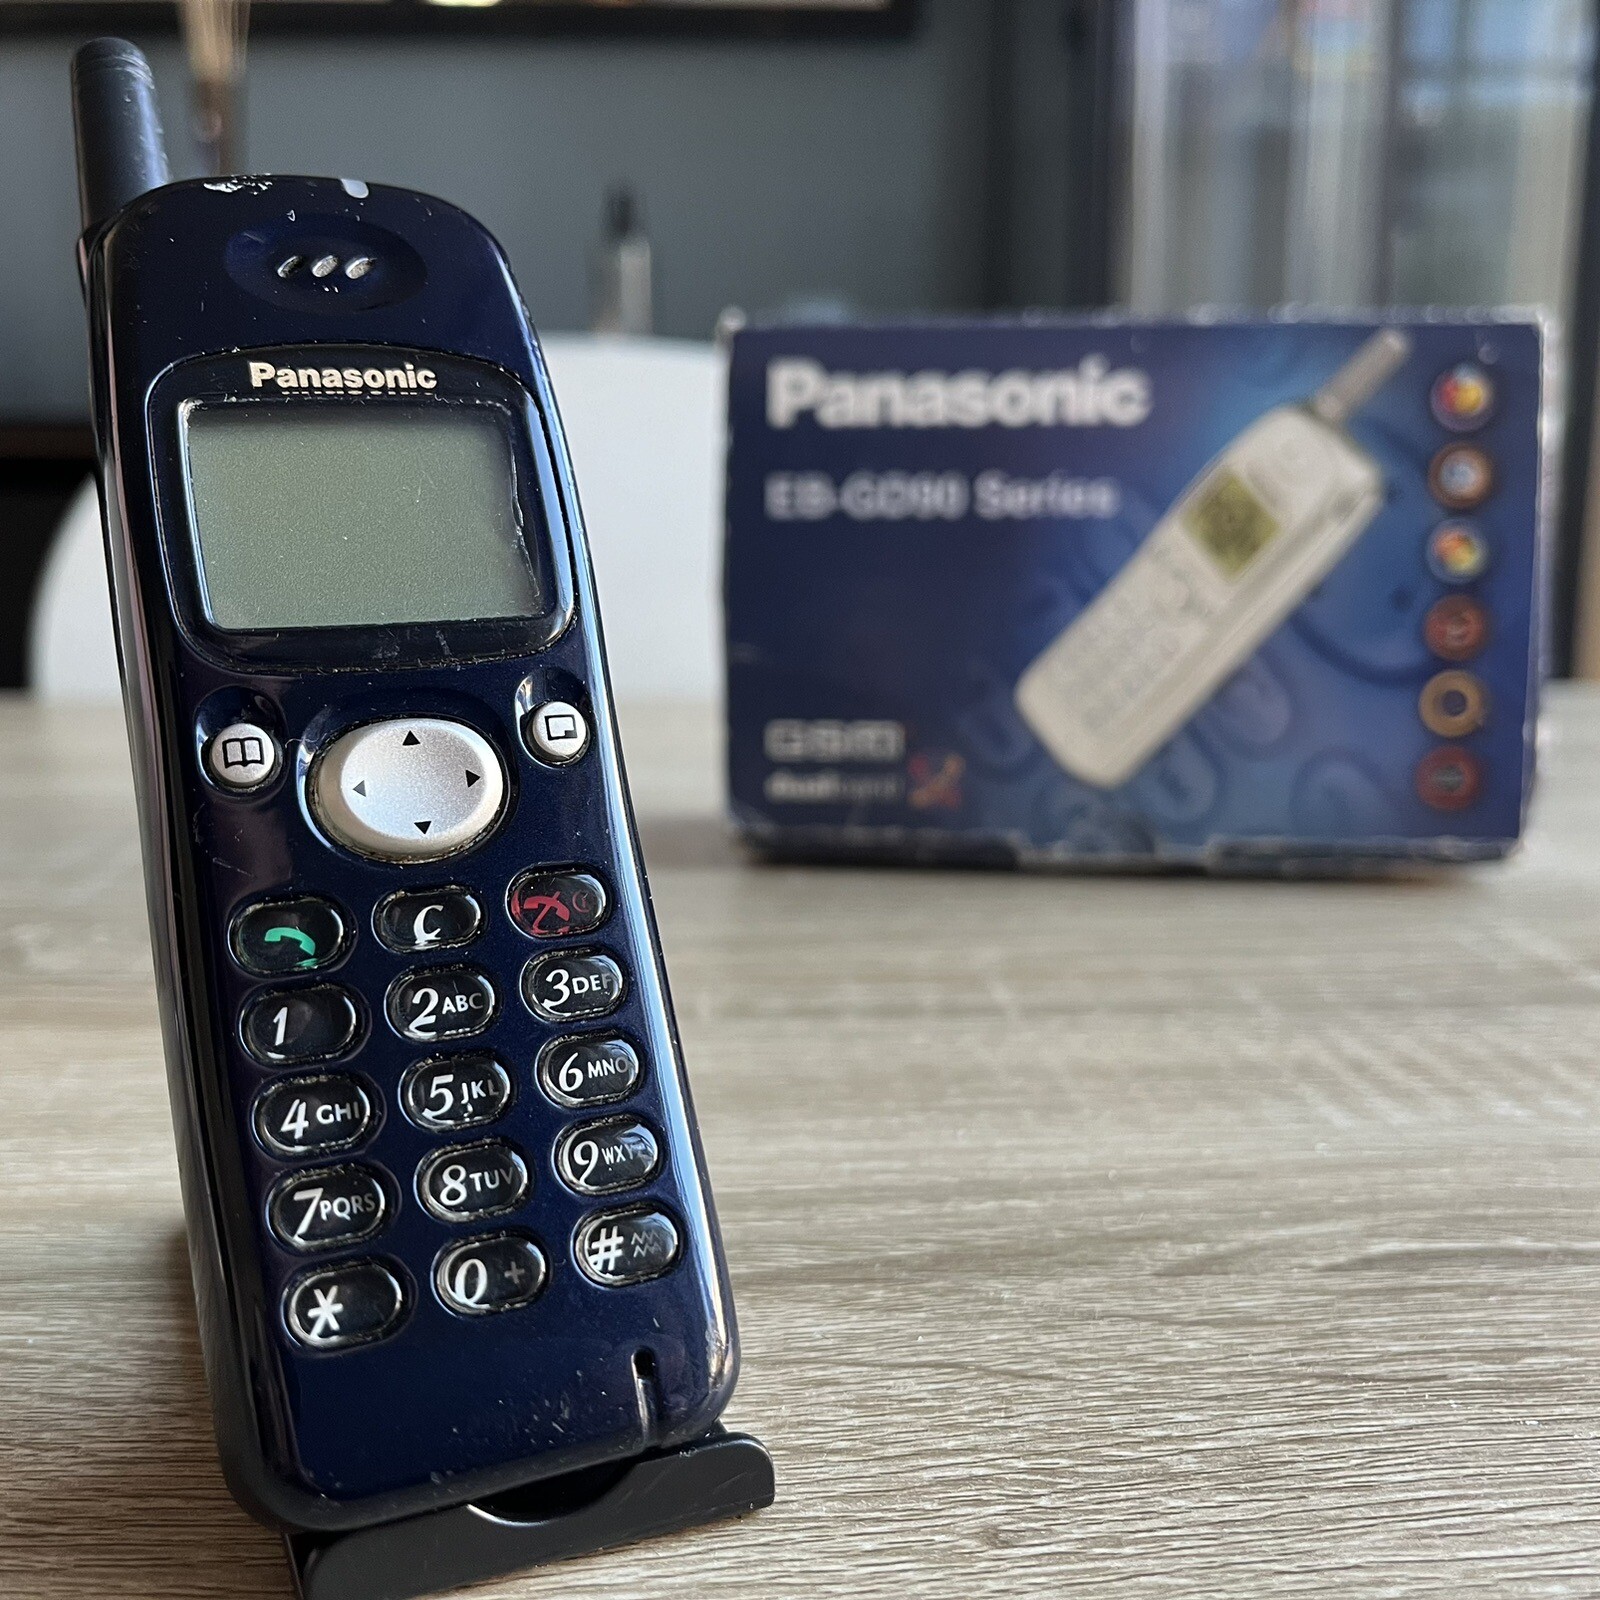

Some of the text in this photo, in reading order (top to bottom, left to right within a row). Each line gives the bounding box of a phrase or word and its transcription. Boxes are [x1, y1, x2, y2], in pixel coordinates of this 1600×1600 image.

[249, 361, 438, 390] Panasonic
[766, 355, 1151, 428] Panasonic
[974, 469, 1121, 520] Series
[413, 905, 443, 942] C
[410, 987, 484, 1026] 2 ABC
[541, 968, 614, 1007] 3 DEF
[273, 1006, 289, 1047] 1
[558, 1052, 630, 1092] 6 MNO
[423, 1073, 502, 1116] 5 JKL
[280, 1098, 362, 1140] 4 GHI
[573, 1140, 599, 1186] 9
[439, 1164, 514, 1206] 8 TUV
[292, 1187, 376, 1237] 7 PQRS
[454, 1257, 488, 1305] 0
